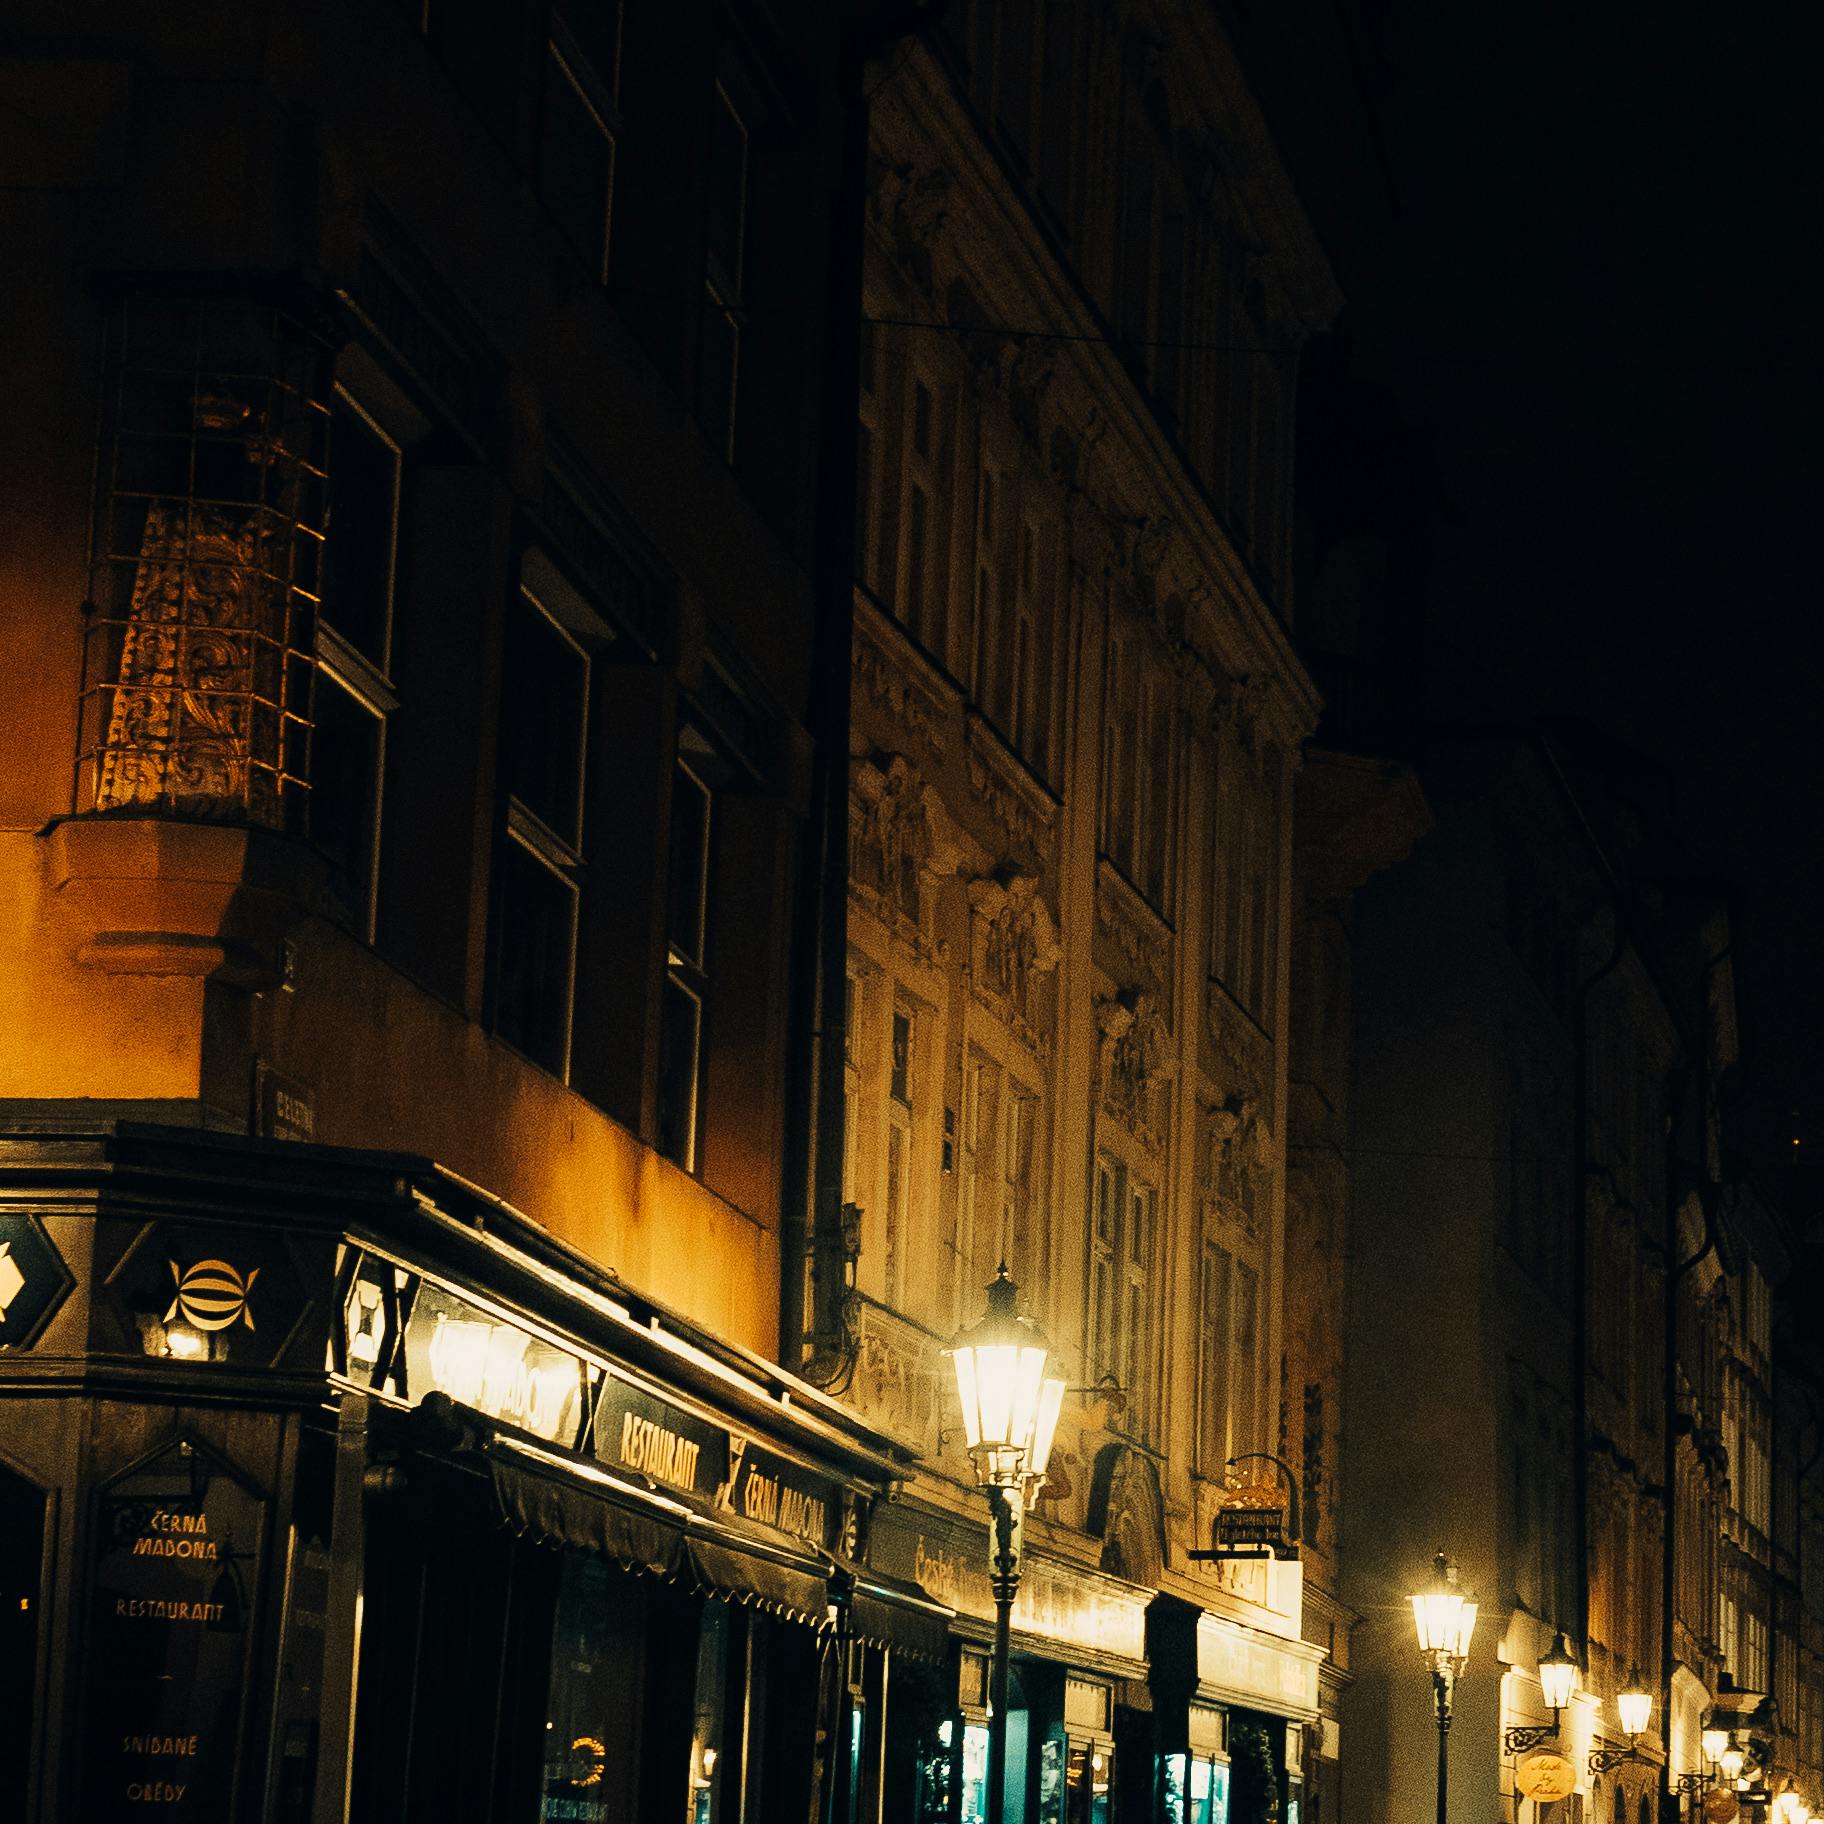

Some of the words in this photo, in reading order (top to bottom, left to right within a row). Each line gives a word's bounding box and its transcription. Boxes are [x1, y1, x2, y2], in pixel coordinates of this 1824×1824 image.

[621, 1412, 699, 1491] RESTAURANT
[745, 1462, 779, 1526] ČERNÁ
[151, 1509, 207, 1534] ČERNÁ
[132, 1537, 217, 1560] MADONA
[115, 1598, 224, 1622] RESTAURANT
